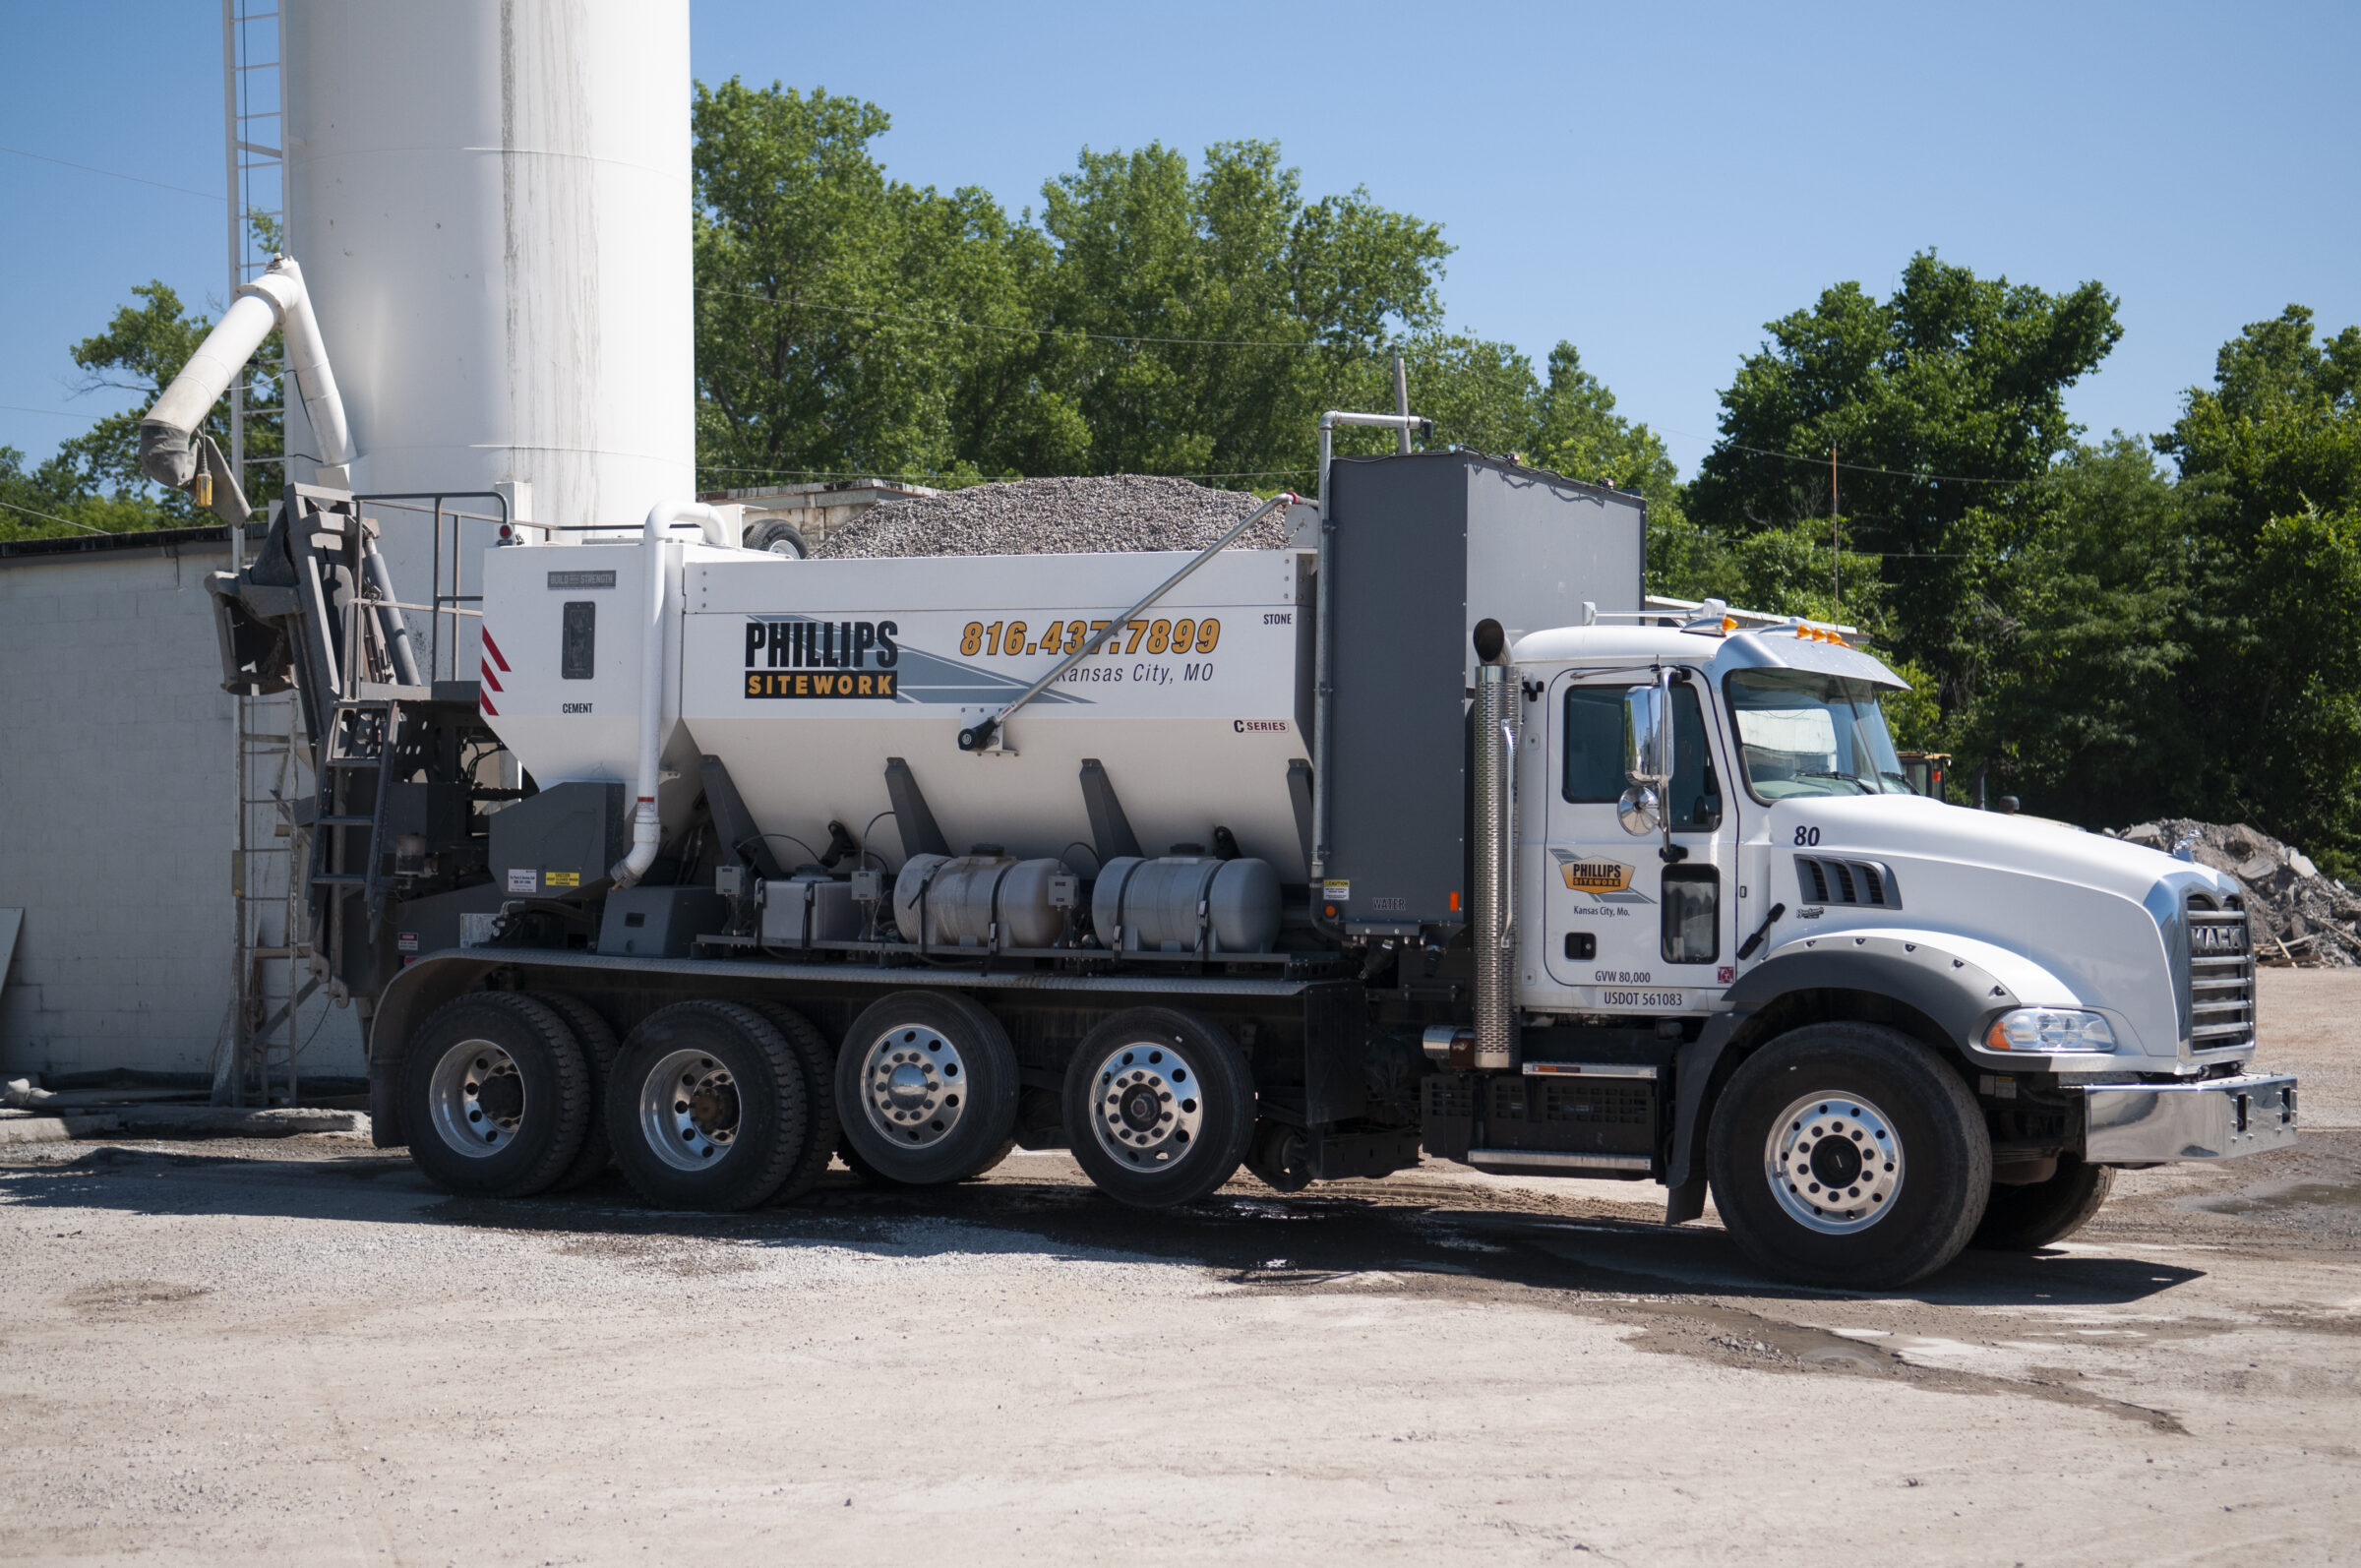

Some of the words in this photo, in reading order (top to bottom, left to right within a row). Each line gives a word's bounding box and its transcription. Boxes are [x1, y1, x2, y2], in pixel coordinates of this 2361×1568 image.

[1263, 614, 1292, 625] STONE
[960, 618, 1221, 656] 816.437.7899
[745, 621, 898, 668] PHILLIPS
[1133, 663, 1175, 685] City,
[1183, 663, 1214, 682] MO
[748, 675, 893, 695] SITEWORK
[562, 702, 593, 714] CEMENT
[1234, 719, 1244, 733] C
[1246, 721, 1286, 731] SERIES
[1793, 825, 1821, 846] 80
[1573, 864, 1620, 877] PHILLIPS
[1372, 897, 1406, 910] WATER
[1573, 905, 1599, 916] Kansas
[1600, 906, 1615, 918] City,
[1616, 907, 1630, 917] Mo.
[2190, 927, 2243, 949] MACK
[1595, 971, 1616, 982] GVW
[1619, 972, 1651, 984] 80,000
[1604, 991, 1640, 1005] USDOT
[1642, 992, 1682, 1006] 561083
